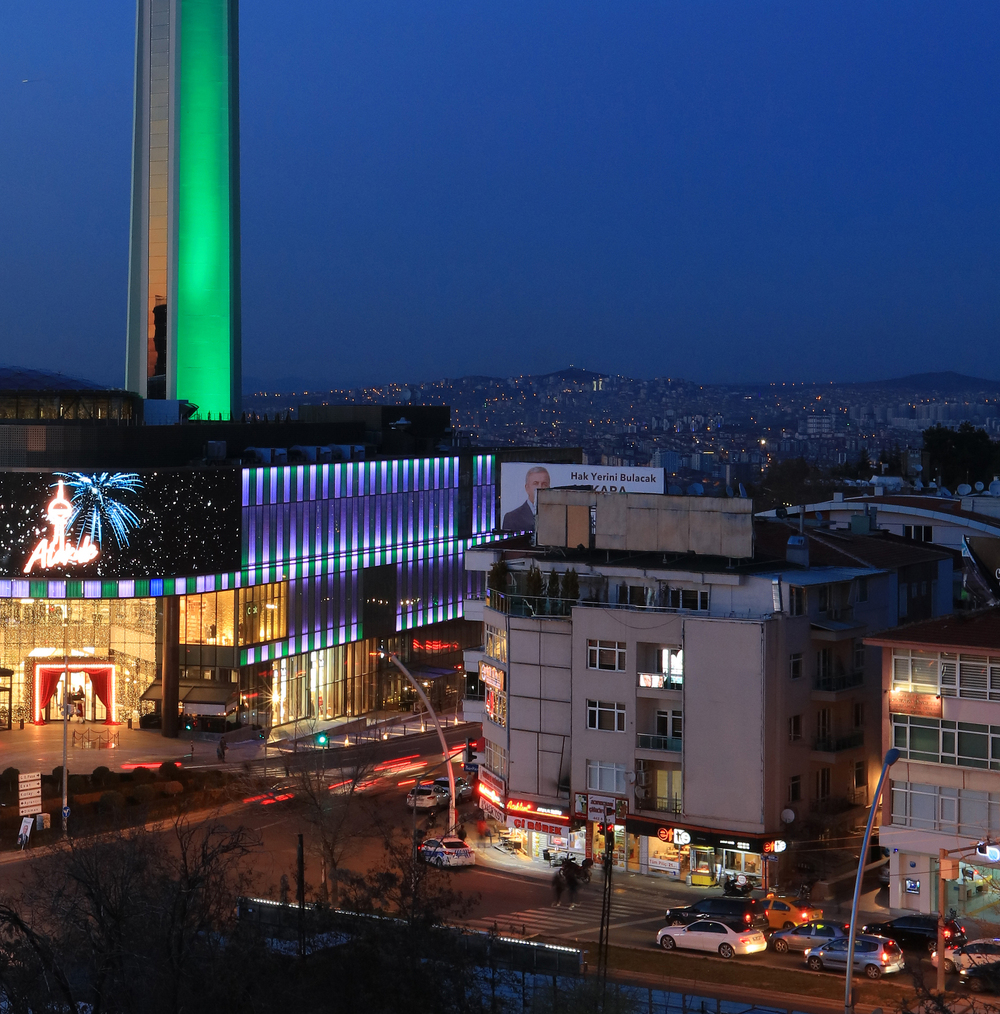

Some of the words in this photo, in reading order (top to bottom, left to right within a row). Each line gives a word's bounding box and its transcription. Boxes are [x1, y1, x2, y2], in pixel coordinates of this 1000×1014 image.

[570, 472, 588, 480] Hak
[591, 472, 618, 482] Yerini
[620, 473, 656, 483] Bulacak
